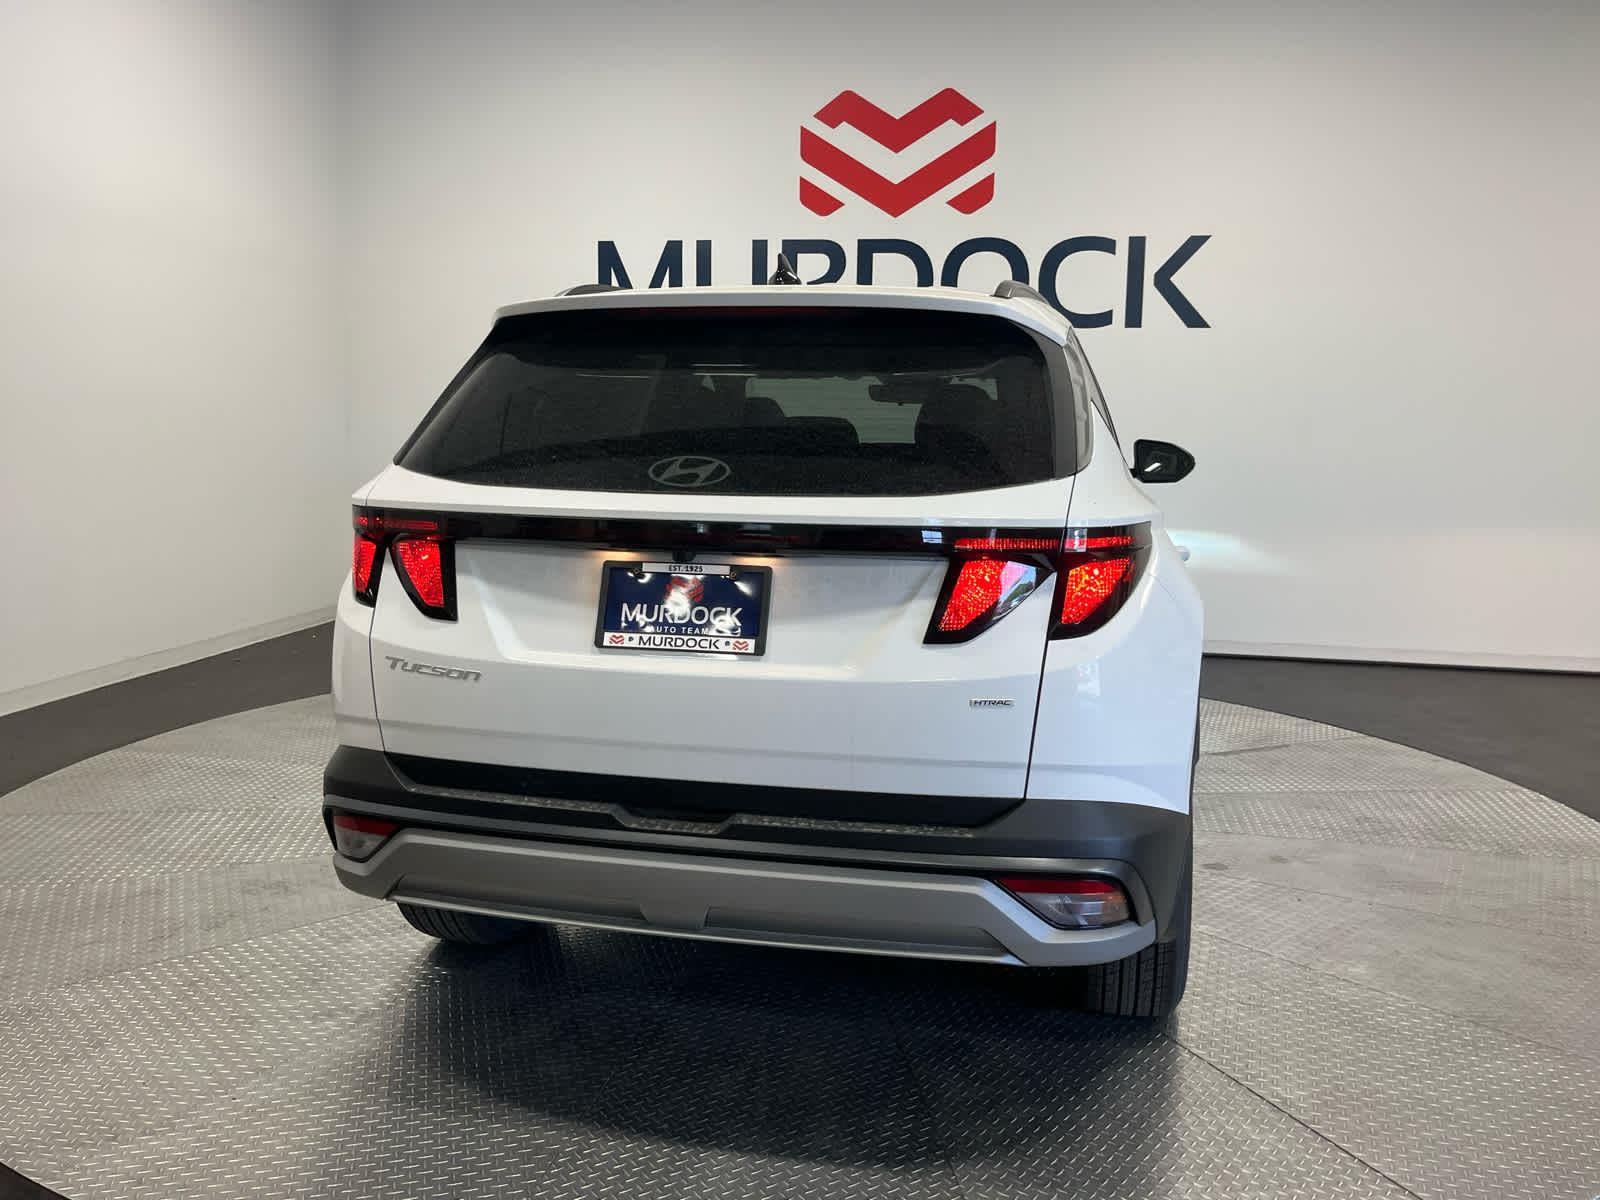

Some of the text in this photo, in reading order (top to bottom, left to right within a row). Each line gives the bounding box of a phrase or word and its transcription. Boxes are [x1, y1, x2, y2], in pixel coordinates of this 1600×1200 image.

[620, 602, 743, 627] MURDOCK
[649, 626, 711, 635] UTO TEAM
[638, 635, 720, 650] MURDOCK
[972, 699, 1013, 707] HTRAC
